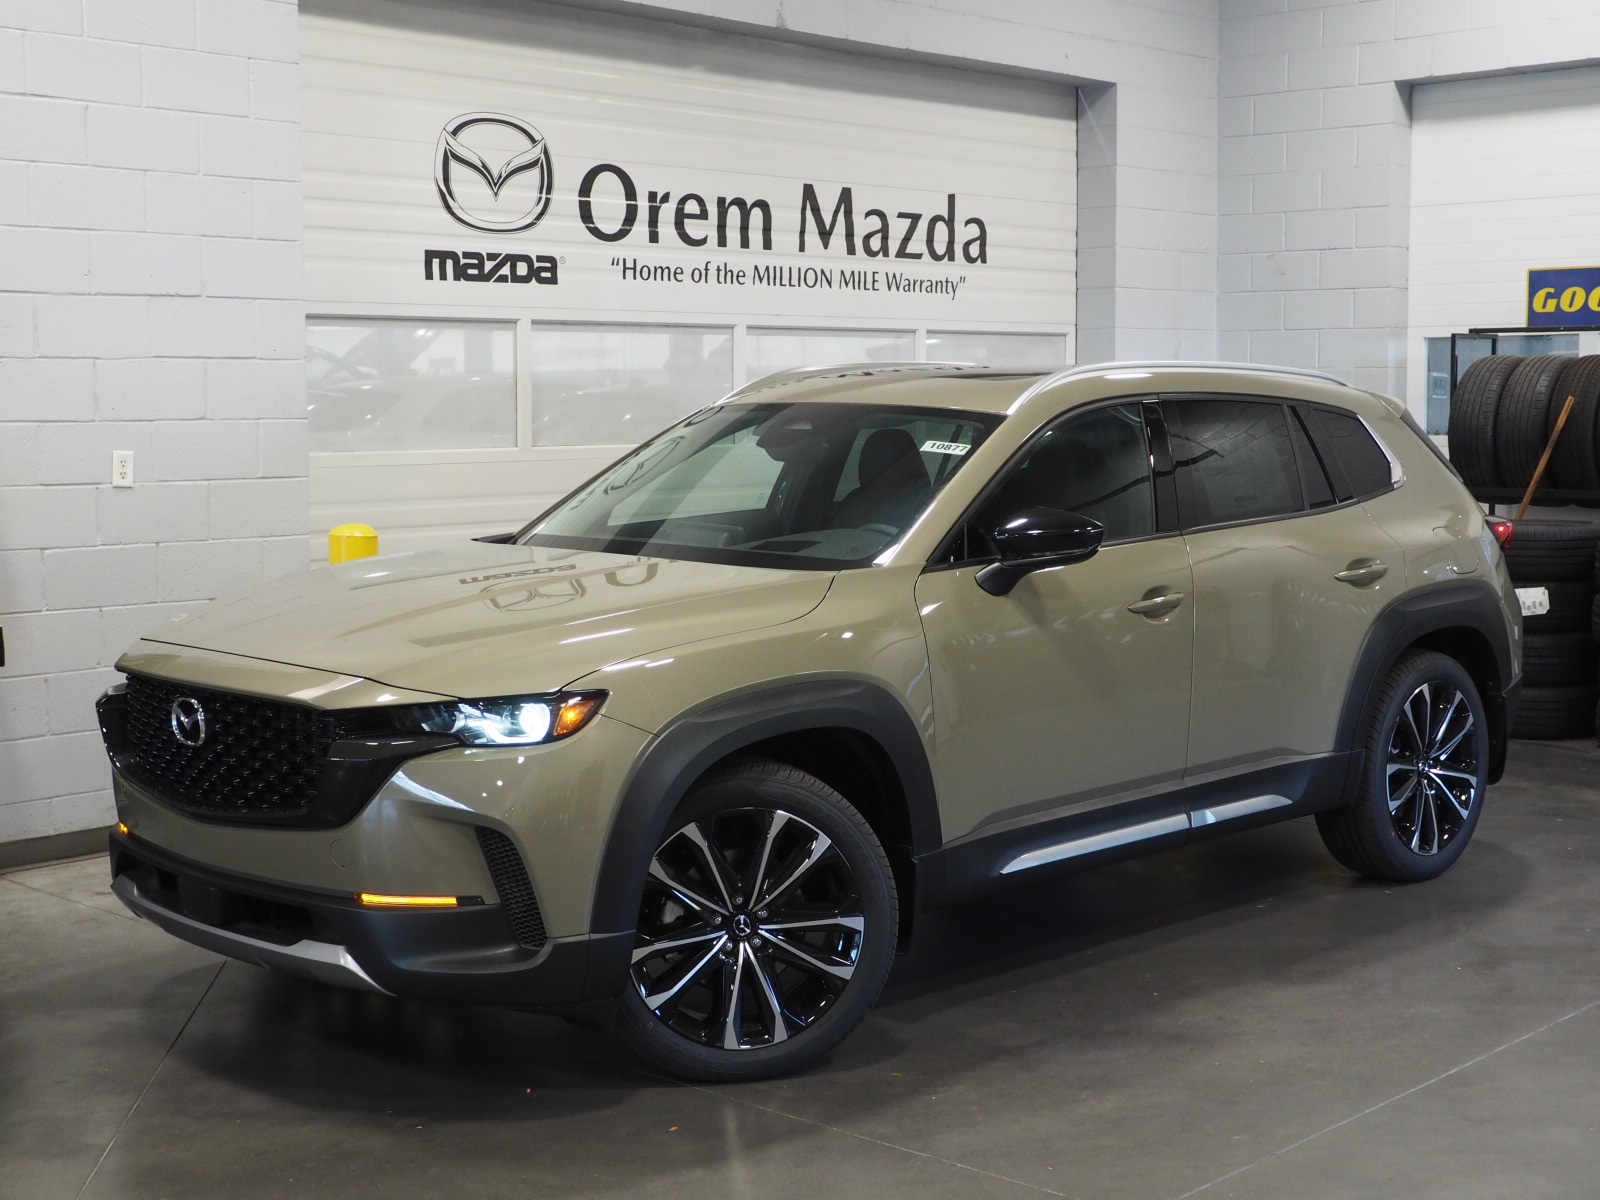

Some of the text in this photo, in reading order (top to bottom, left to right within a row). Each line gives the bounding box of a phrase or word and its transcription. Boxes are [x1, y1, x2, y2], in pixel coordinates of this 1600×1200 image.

[578, 163, 988, 264] Orem Mazda
[690, 260, 711, 284] of
[715, 262, 746, 286] the
[752, 264, 833, 289] MILLION
[839, 269, 880, 292] MILE
[930, 442, 968, 453] 10877
